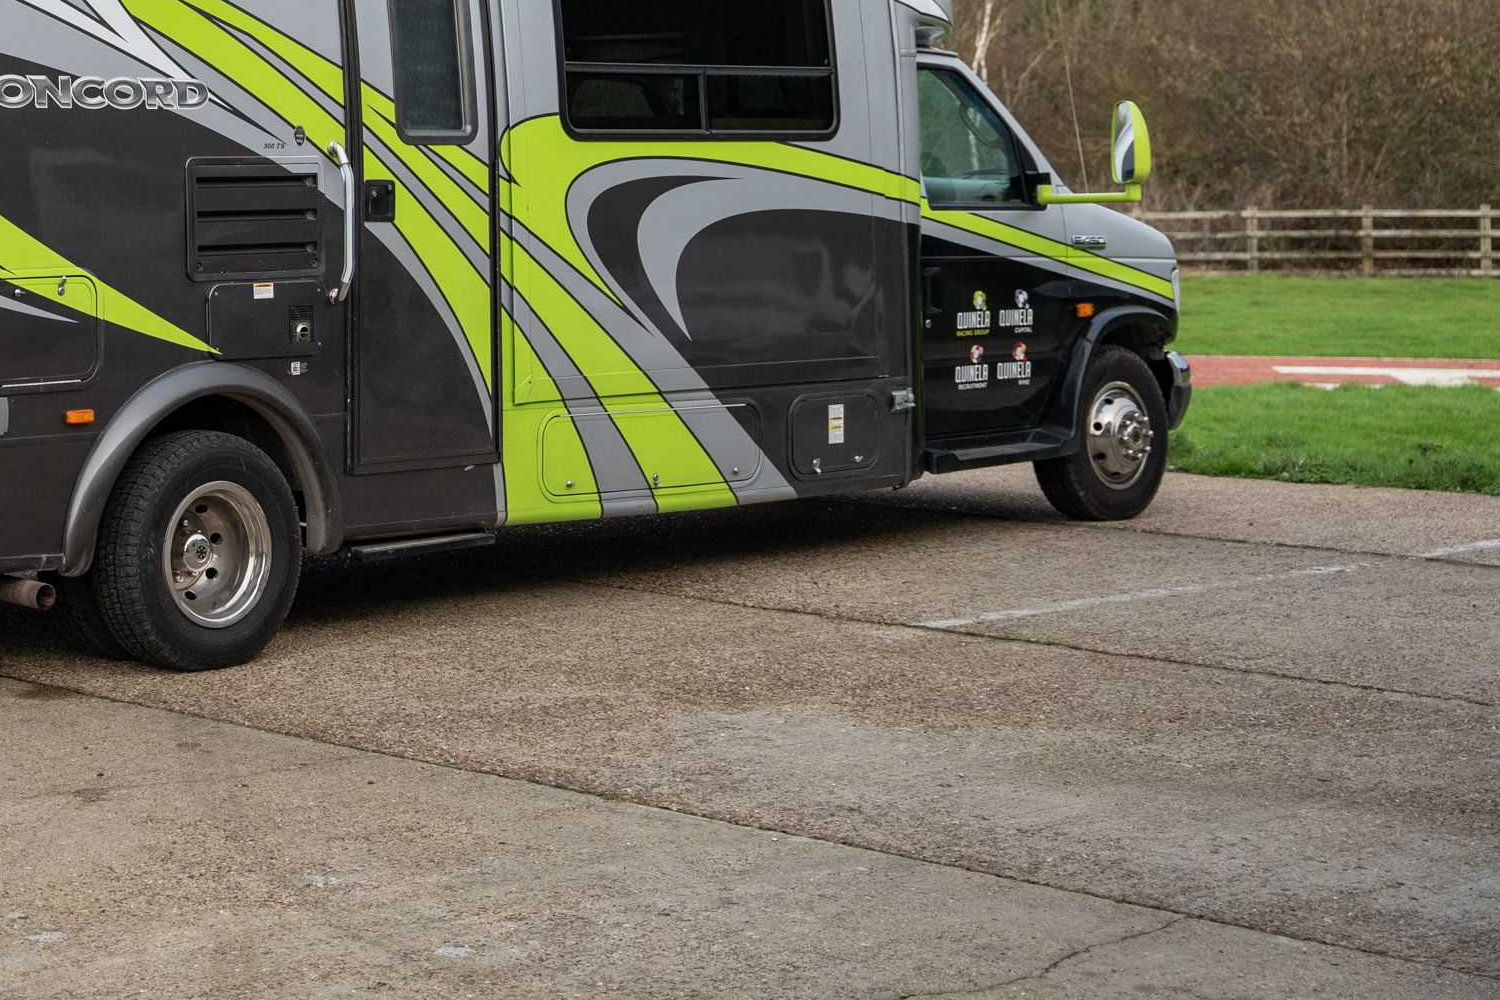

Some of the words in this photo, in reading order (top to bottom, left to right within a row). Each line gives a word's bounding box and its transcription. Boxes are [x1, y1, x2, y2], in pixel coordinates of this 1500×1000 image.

[957, 310, 991, 329] QUINELA
[999, 308, 1033, 327] QUINELA
[955, 364, 989, 383] QUINELA
[997, 361, 1031, 379] QUINELA
